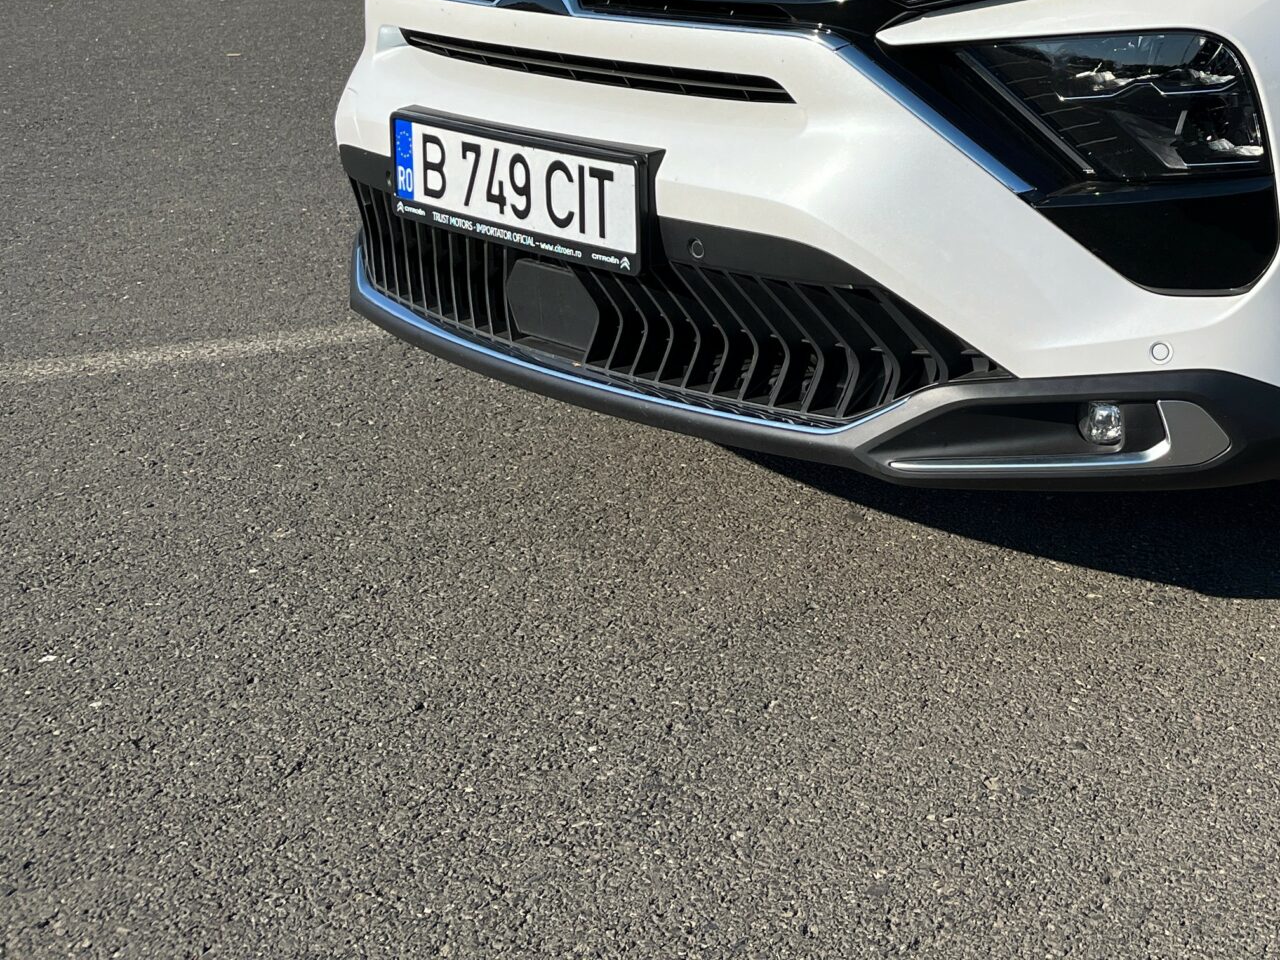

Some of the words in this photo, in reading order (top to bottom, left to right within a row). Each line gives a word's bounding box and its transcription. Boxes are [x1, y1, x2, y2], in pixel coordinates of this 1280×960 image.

[397, 166, 413, 192] RO
[422, 133, 447, 199] B
[461, 141, 532, 220] 749
[545, 160, 614, 239] CIT
[432, 211, 449, 225] TRUST
[449, 215, 473, 231] MOTORS
[476, 223, 512, 241] IMPORTATOR
[512, 233, 535, 247] OFICIAL
[540, 242, 582, 258] www.citroen.ro
